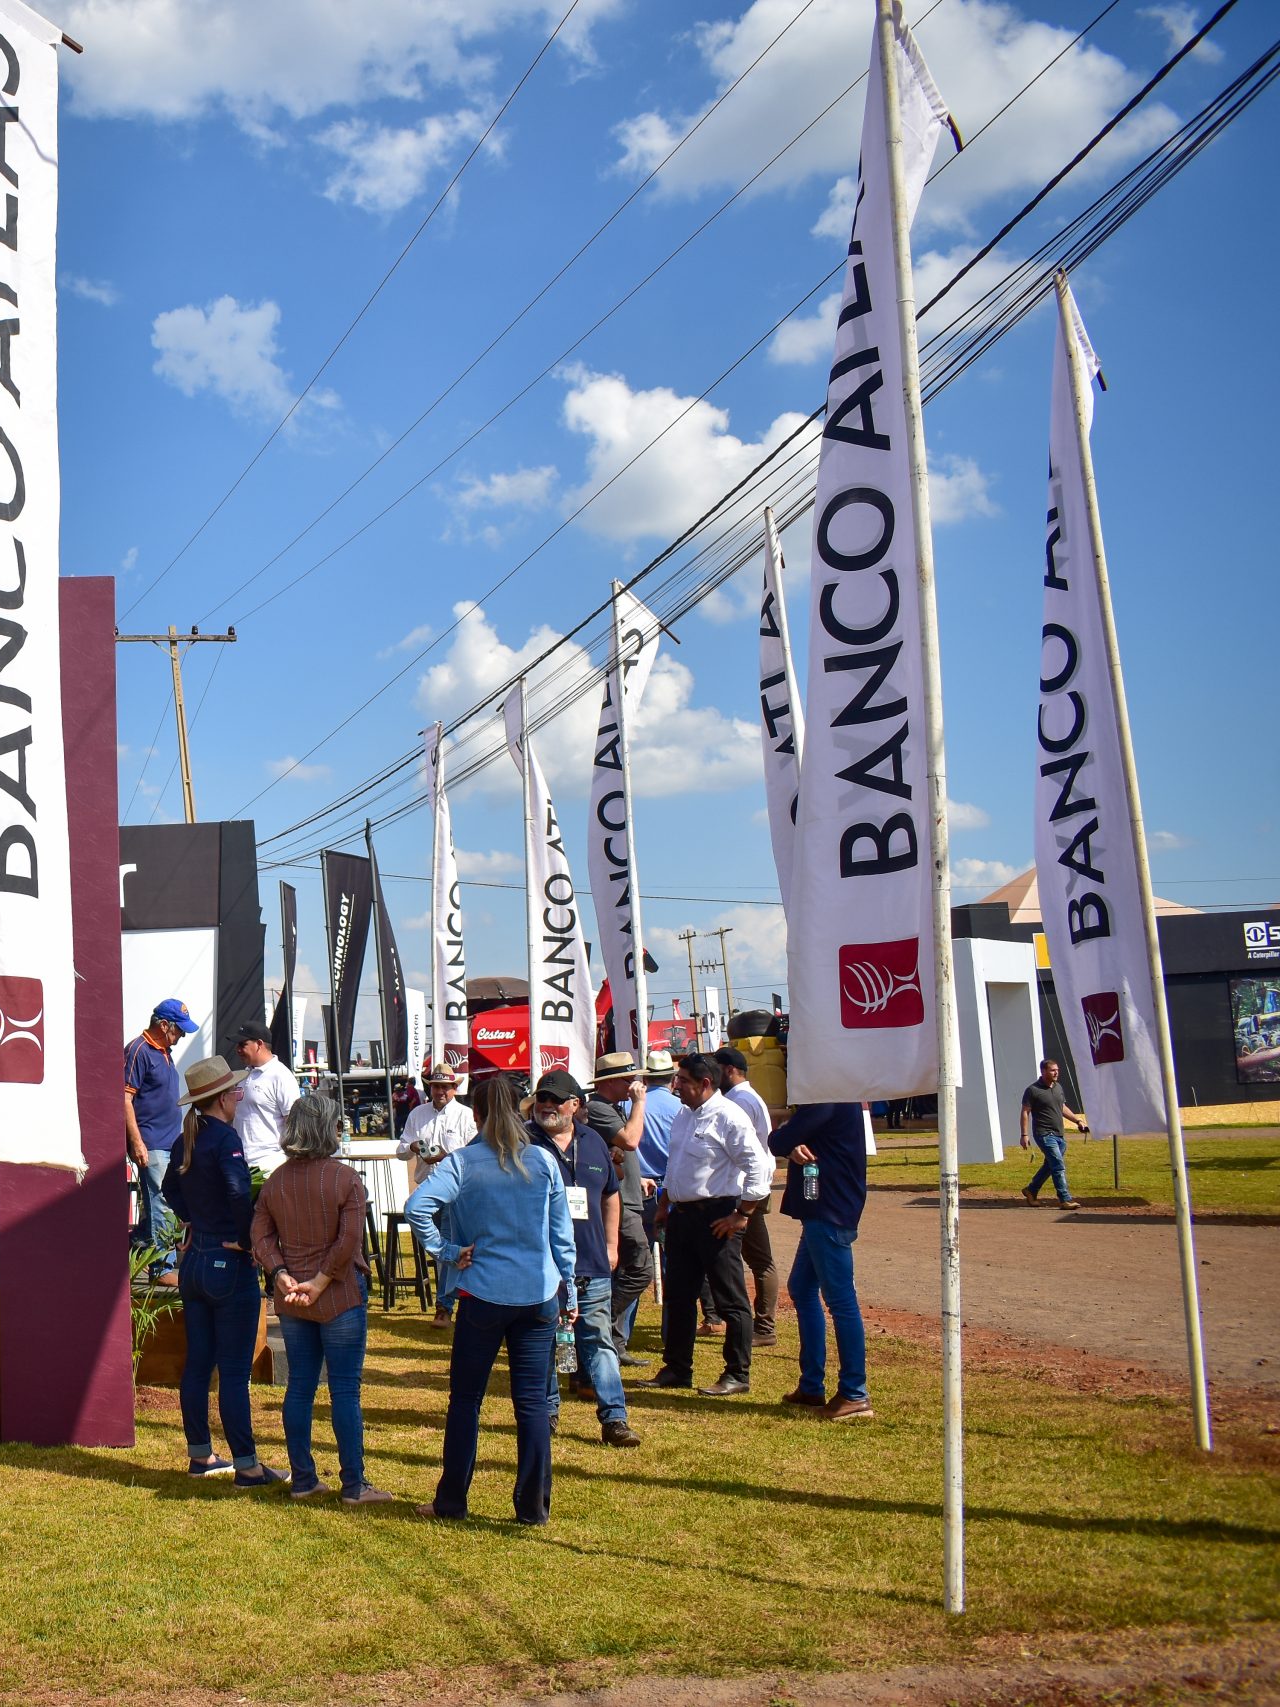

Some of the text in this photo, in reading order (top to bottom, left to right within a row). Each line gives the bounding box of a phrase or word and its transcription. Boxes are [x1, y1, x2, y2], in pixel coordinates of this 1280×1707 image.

[817, 487, 918, 878] BANCO
[1038, 623, 1110, 944] BANCO
[334, 892, 350, 995] ECHNOLOGY
[541, 873, 575, 1022] BANCO
[476, 1028, 516, 1040] Cestari
